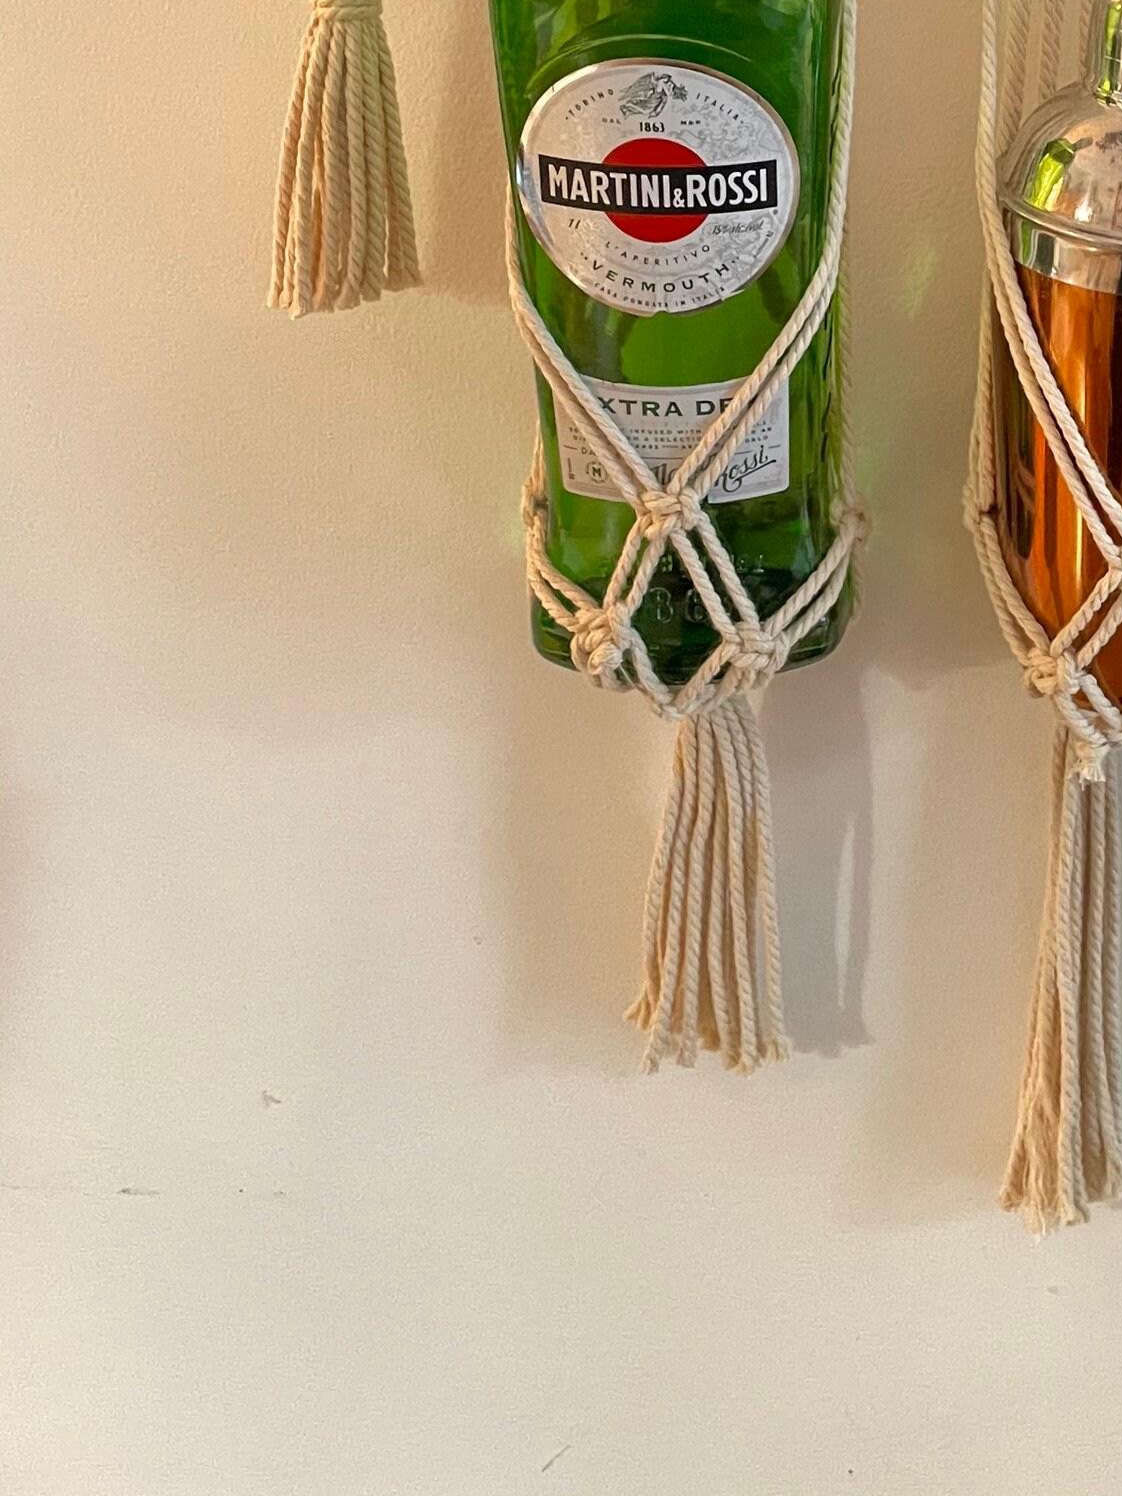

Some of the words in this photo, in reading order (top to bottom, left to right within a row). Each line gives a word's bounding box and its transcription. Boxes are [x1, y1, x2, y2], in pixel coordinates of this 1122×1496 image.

[567, 88, 615, 118] TORINO
[695, 92, 740, 121] ITALIA
[638, 121, 665, 133] 1863
[547, 162, 768, 209] MARTINI&ROSSI
[591, 259, 731, 294] VERMOUTH
[597, 396, 684, 418] XTRA
[654, 436, 703, 445] SELECTIO
